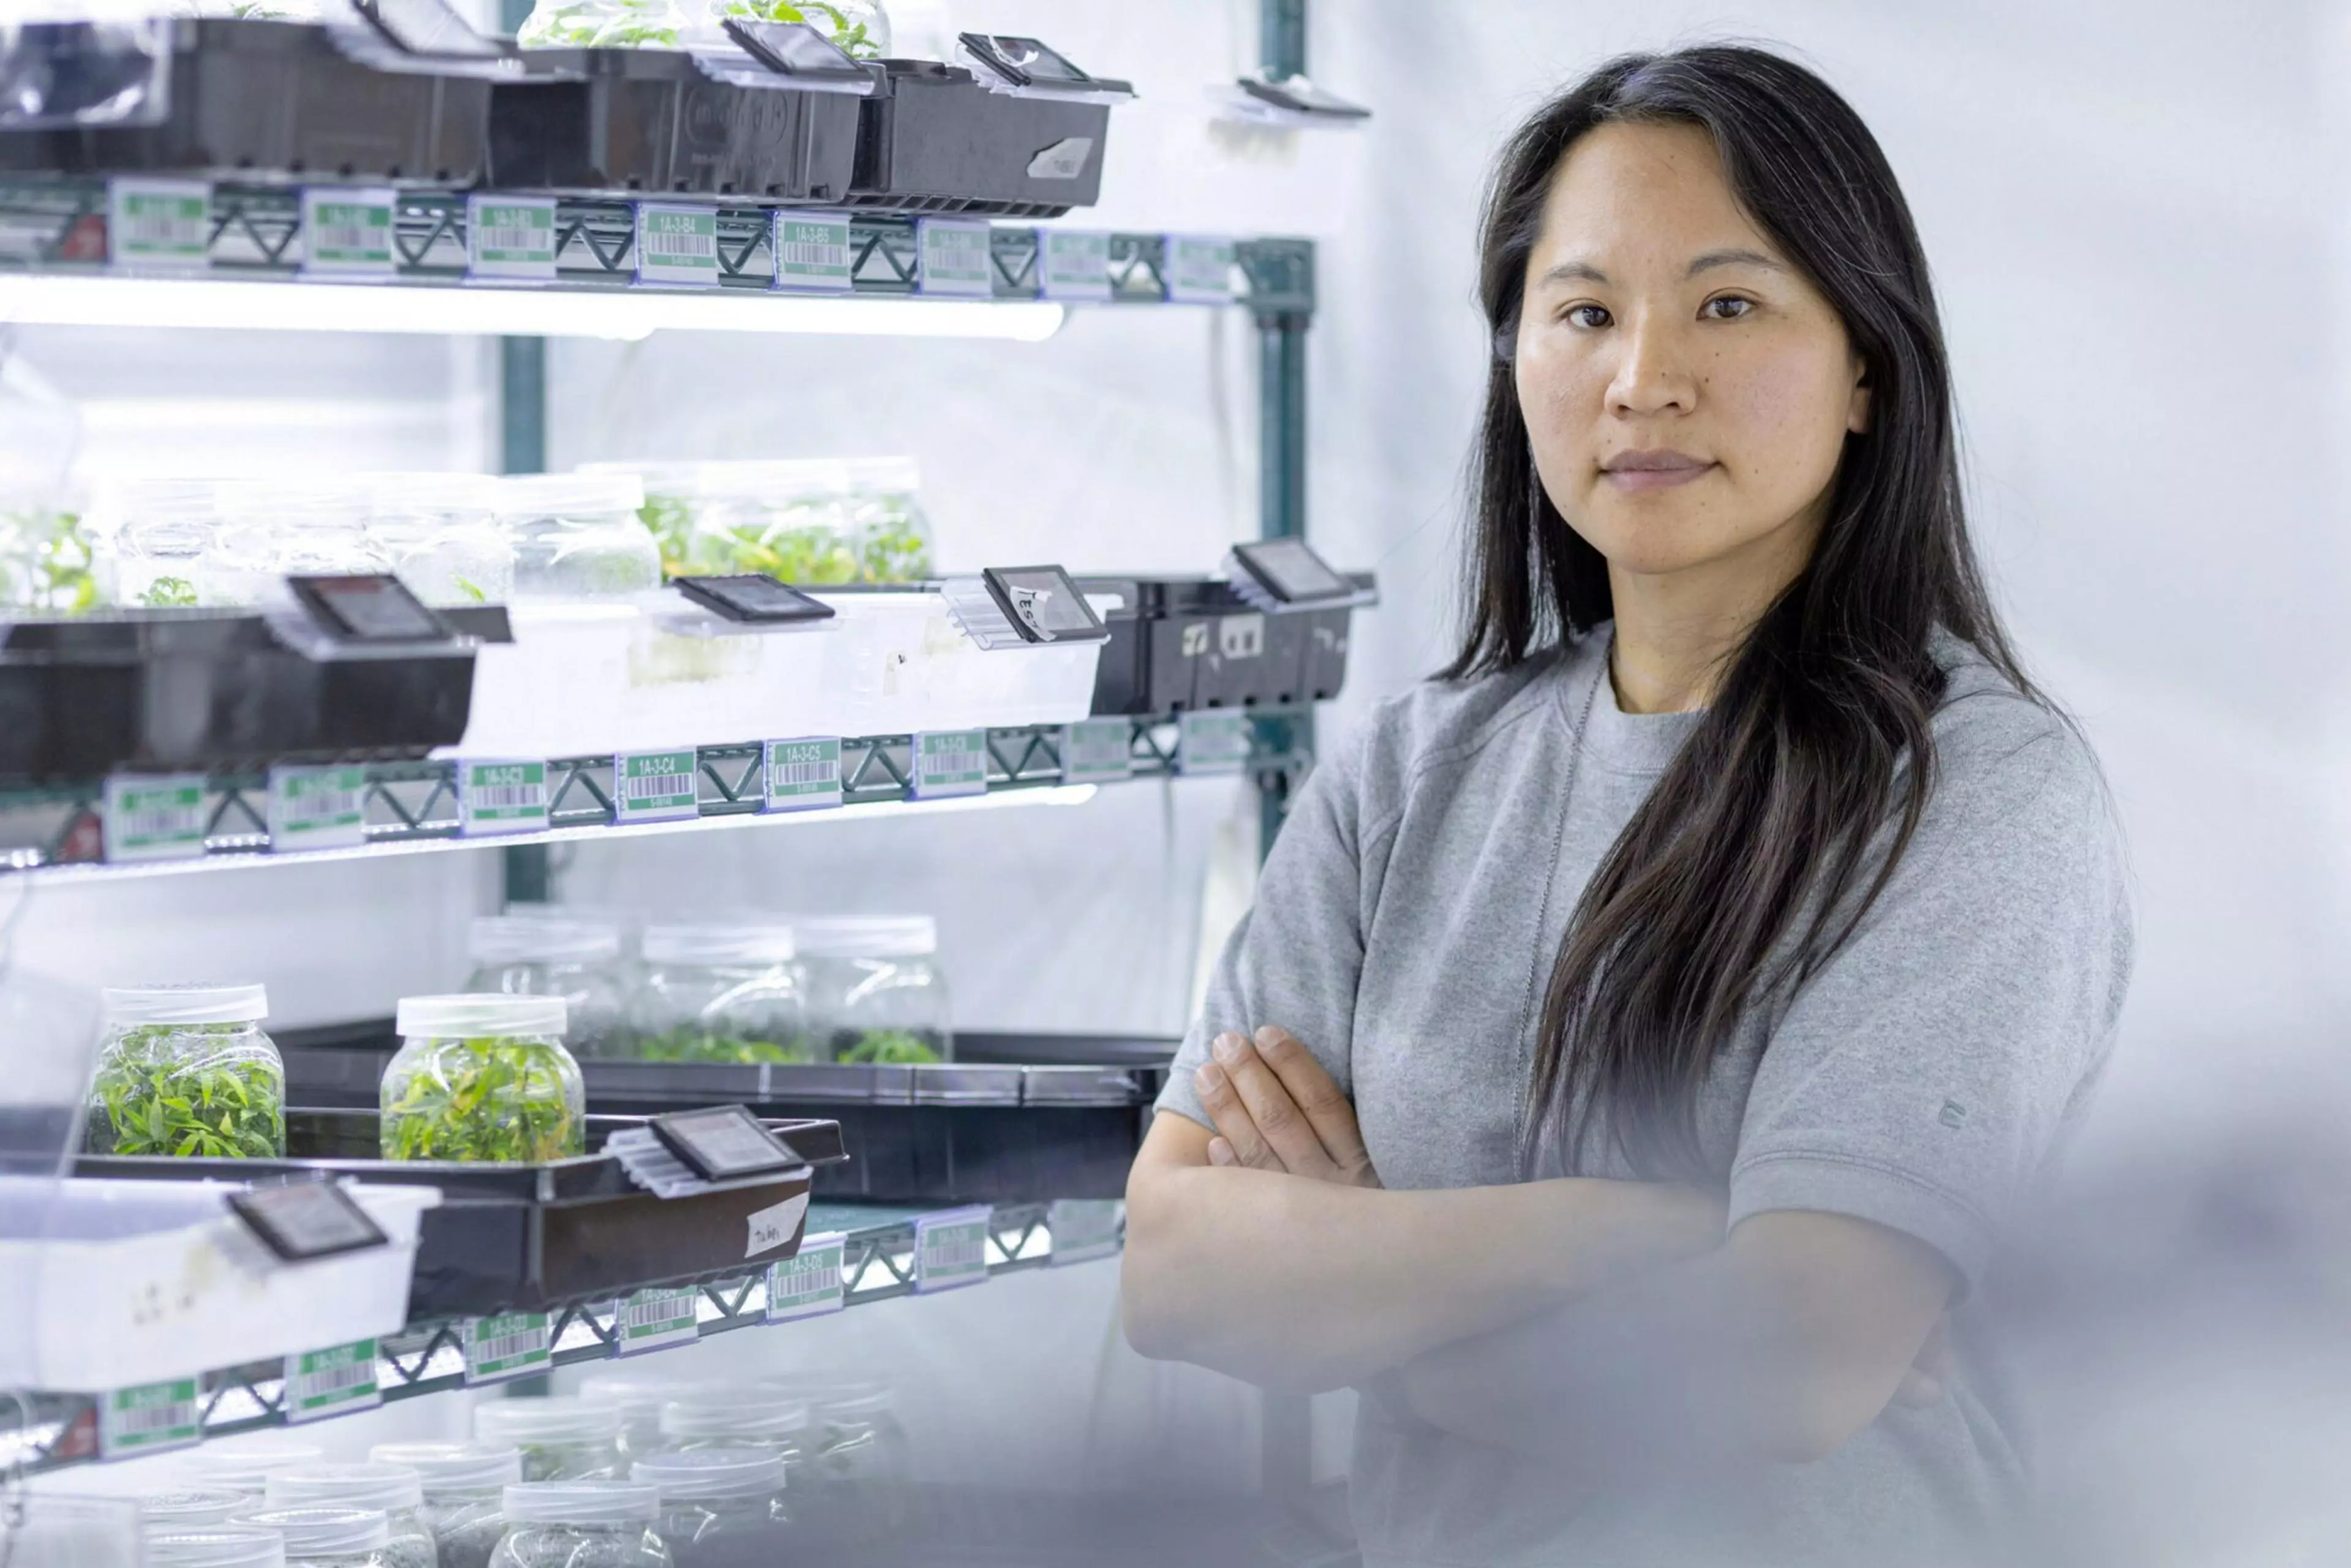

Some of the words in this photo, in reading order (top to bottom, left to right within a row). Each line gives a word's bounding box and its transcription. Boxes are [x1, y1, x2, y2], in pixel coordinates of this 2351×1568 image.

[660, 216, 696, 233] 1A-3-B4
[797, 227, 829, 244] 1A-3-B5
[787, 745, 820, 762] 1A-3-C5
[639, 757, 675, 776] 1A-3-C4
